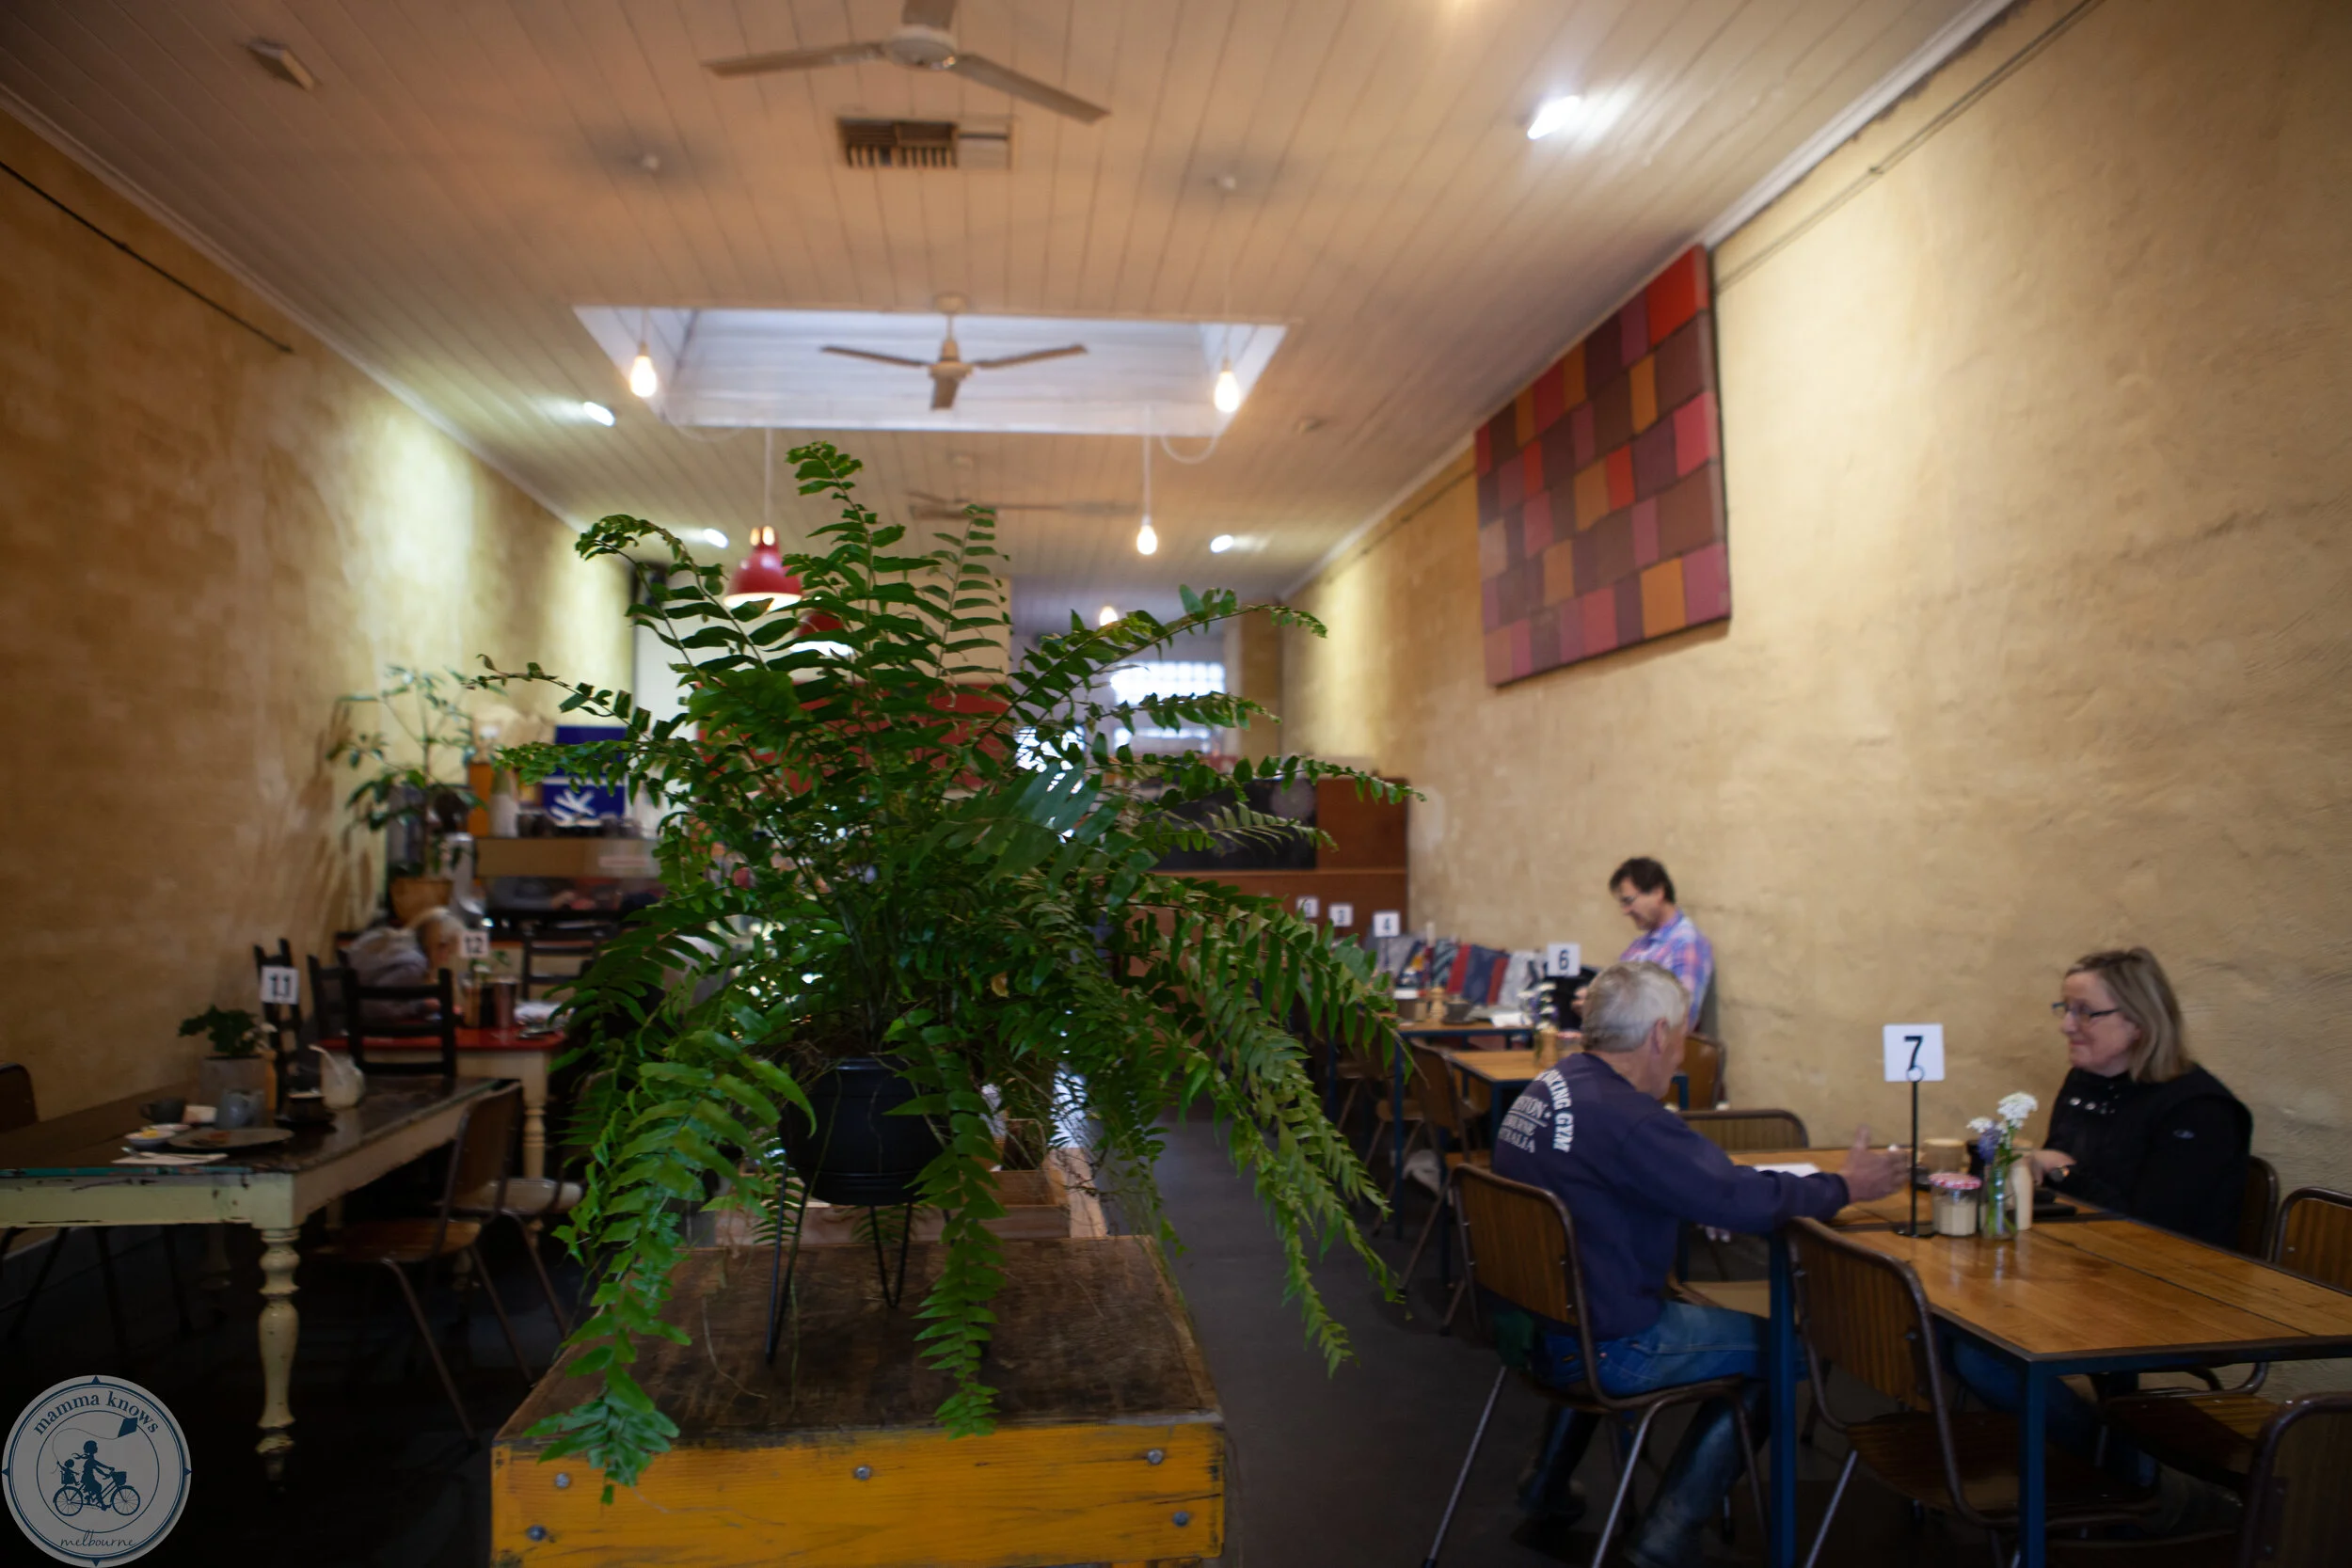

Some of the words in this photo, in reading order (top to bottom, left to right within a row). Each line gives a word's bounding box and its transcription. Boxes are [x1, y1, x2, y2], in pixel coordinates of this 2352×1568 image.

[1558, 948, 1570, 971] 6
[269, 973, 292, 999] 11
[1903, 1035, 1924, 1072] 7
[1553, 1112, 1574, 1153] GYM
